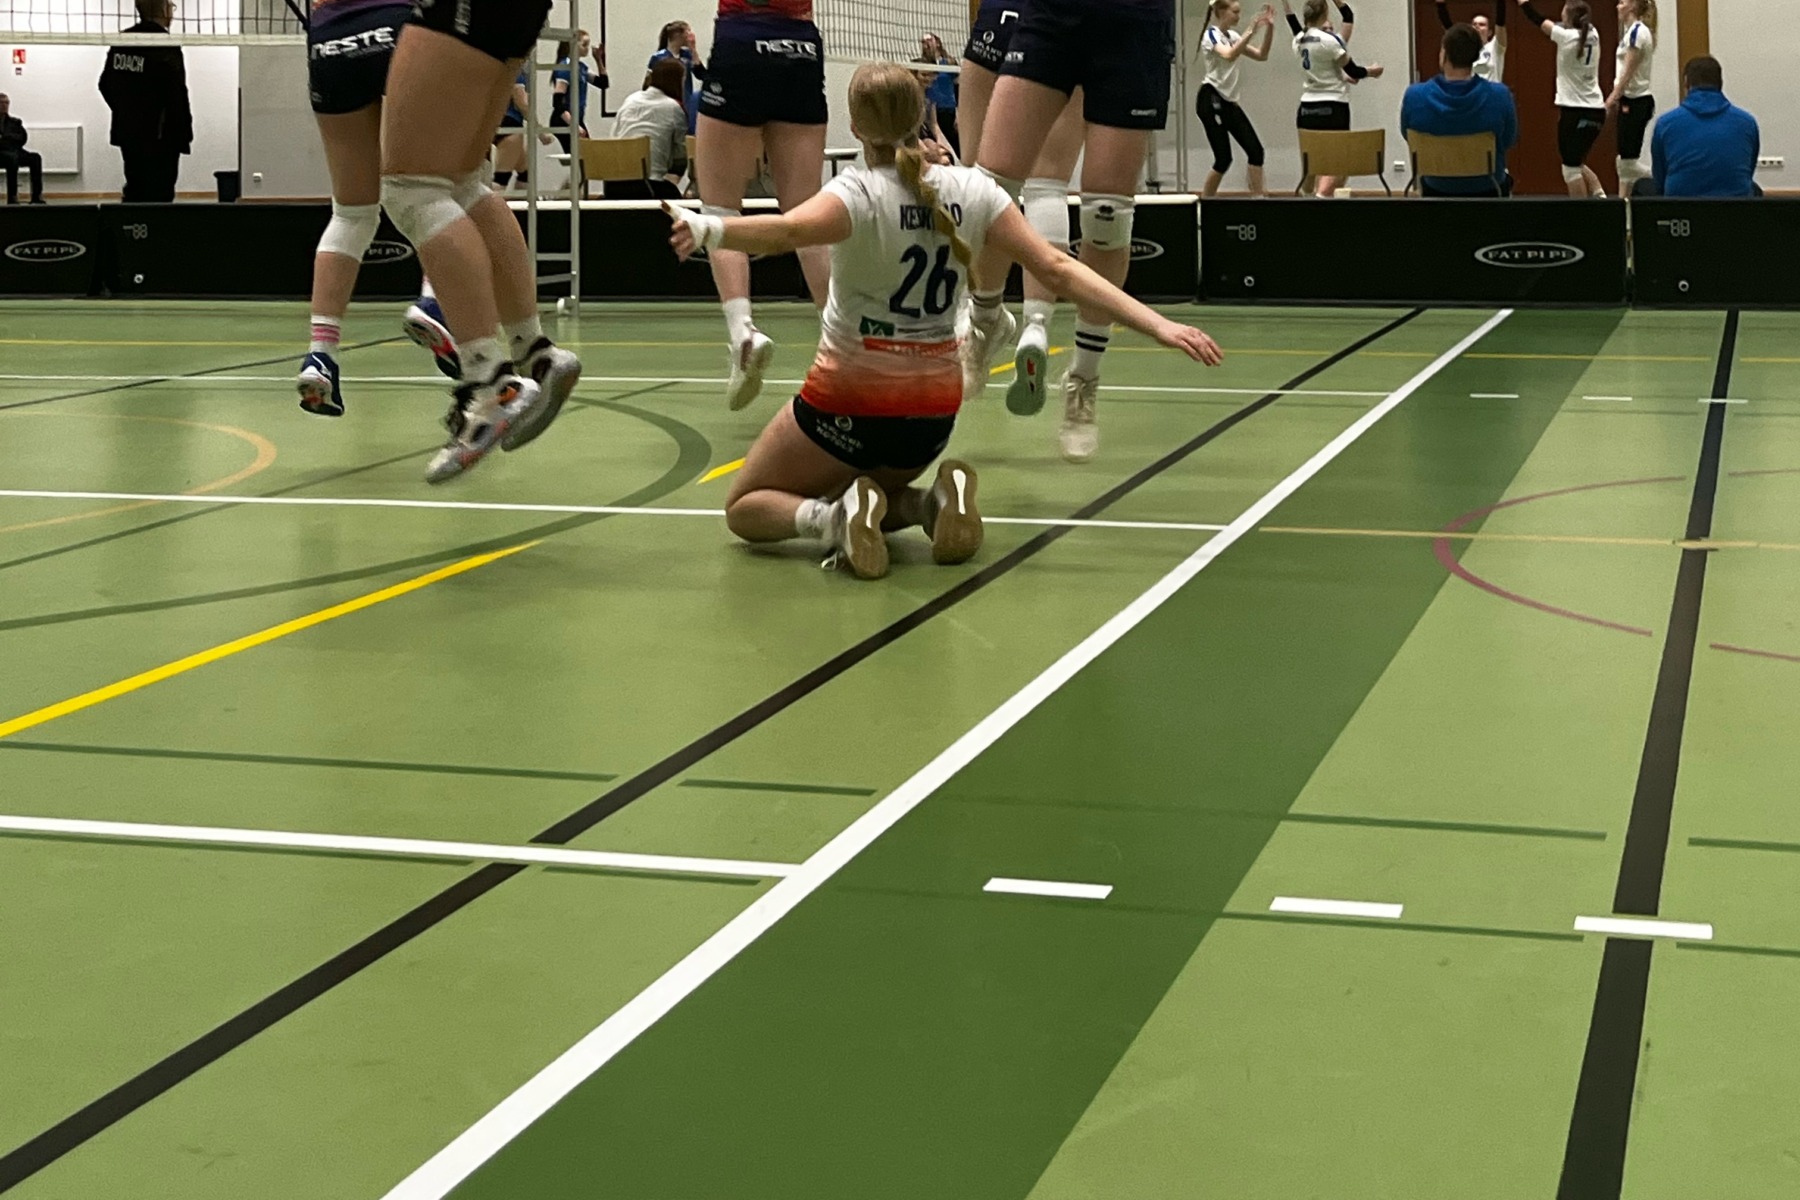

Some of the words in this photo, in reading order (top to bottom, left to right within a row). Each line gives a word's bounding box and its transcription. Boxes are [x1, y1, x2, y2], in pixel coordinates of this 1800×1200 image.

[113, 53, 145, 73] COACH
[14, 247, 40, 255] FAT
[1488, 250, 1522, 259] FAT
[1527, 250, 1574, 259] PIPE
[889, 244, 959, 318] 26
